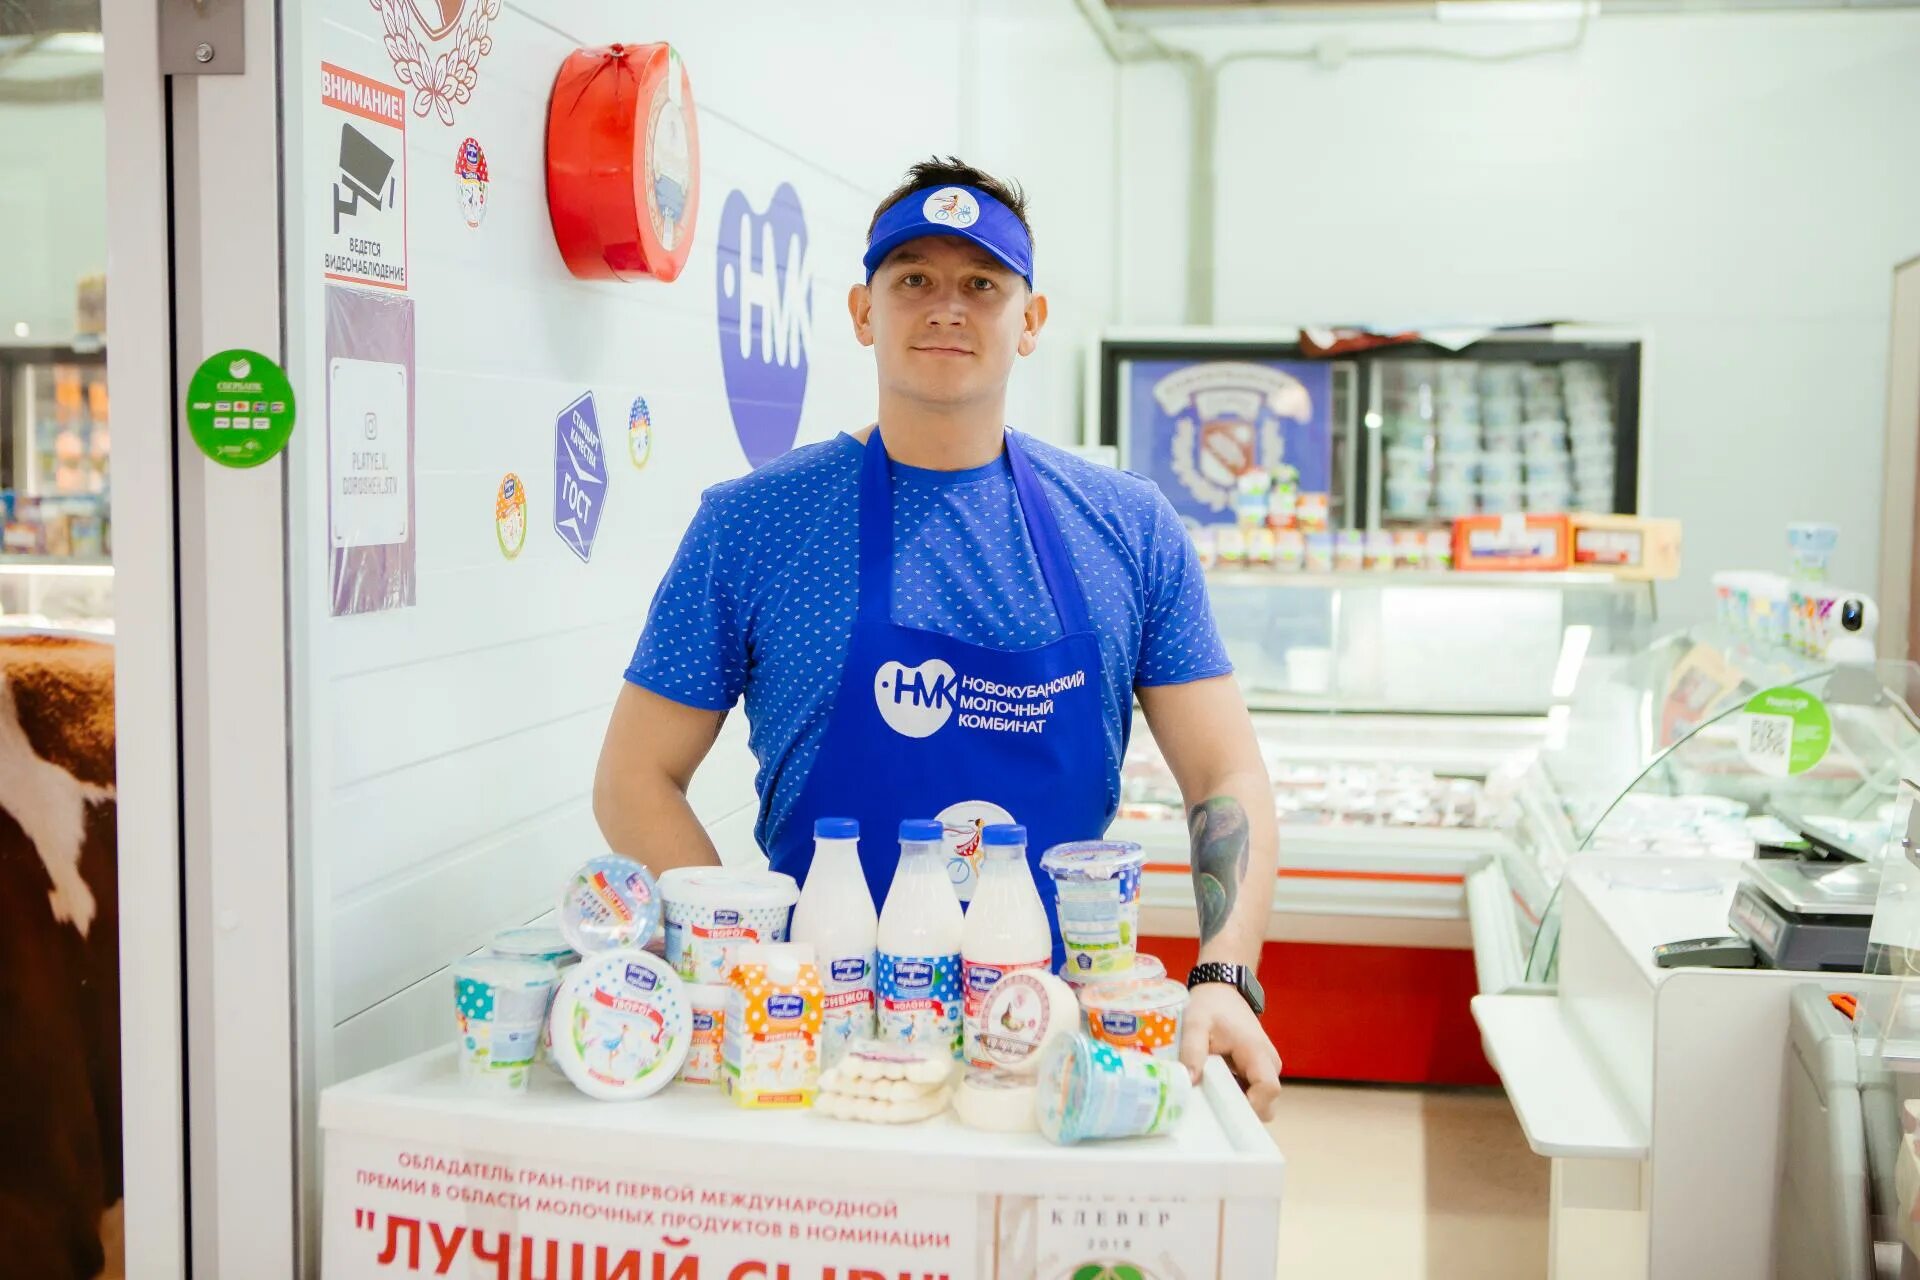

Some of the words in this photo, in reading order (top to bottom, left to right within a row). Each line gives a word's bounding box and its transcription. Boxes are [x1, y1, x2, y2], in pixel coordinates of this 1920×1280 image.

[321, 71, 403, 121] ВНИМАНИЕ!
[349, 237, 381, 258] ВЕДЕТСЯ
[324, 253, 405, 282] ВИДЕОНАБЛЮДЕНИЕ
[572, 410, 600, 451] СТАНДАРТ
[570, 428, 596, 470] КАЧЕСТВА
[562, 472, 592, 525] ГОСТ
[962, 670, 1086, 700] НОВОКУБАНСКИЙ
[959, 694, 1054, 717] МОЛОЧНЫЙ
[958, 713, 1047, 734] КОМБИНАТ
[398, 1151, 515, 1183] ОБЛАДАТЕЛЬ
[519, 1170, 611, 1195] ГРАН-ПРИ
[615, 1181, 694, 1204] ПЕРВОЙ
[700, 1190, 899, 1220] МЕЖДУНАРОДНОЙ
[356, 1169, 426, 1197] ПРЕМИИ
[431, 1183, 441, 1199] В
[446, 1186, 530, 1212] ОБЛАСТИ
[535, 1197, 655, 1226] МОЛОЧНЫХ
[661, 1212, 783, 1239] ПРОДУКТОВ
[789, 1224, 800, 1240] В
[806, 1225, 951, 1250] НОМИНАЦИИ
[1051, 1208, 1170, 1228] КЛЕВЕР
